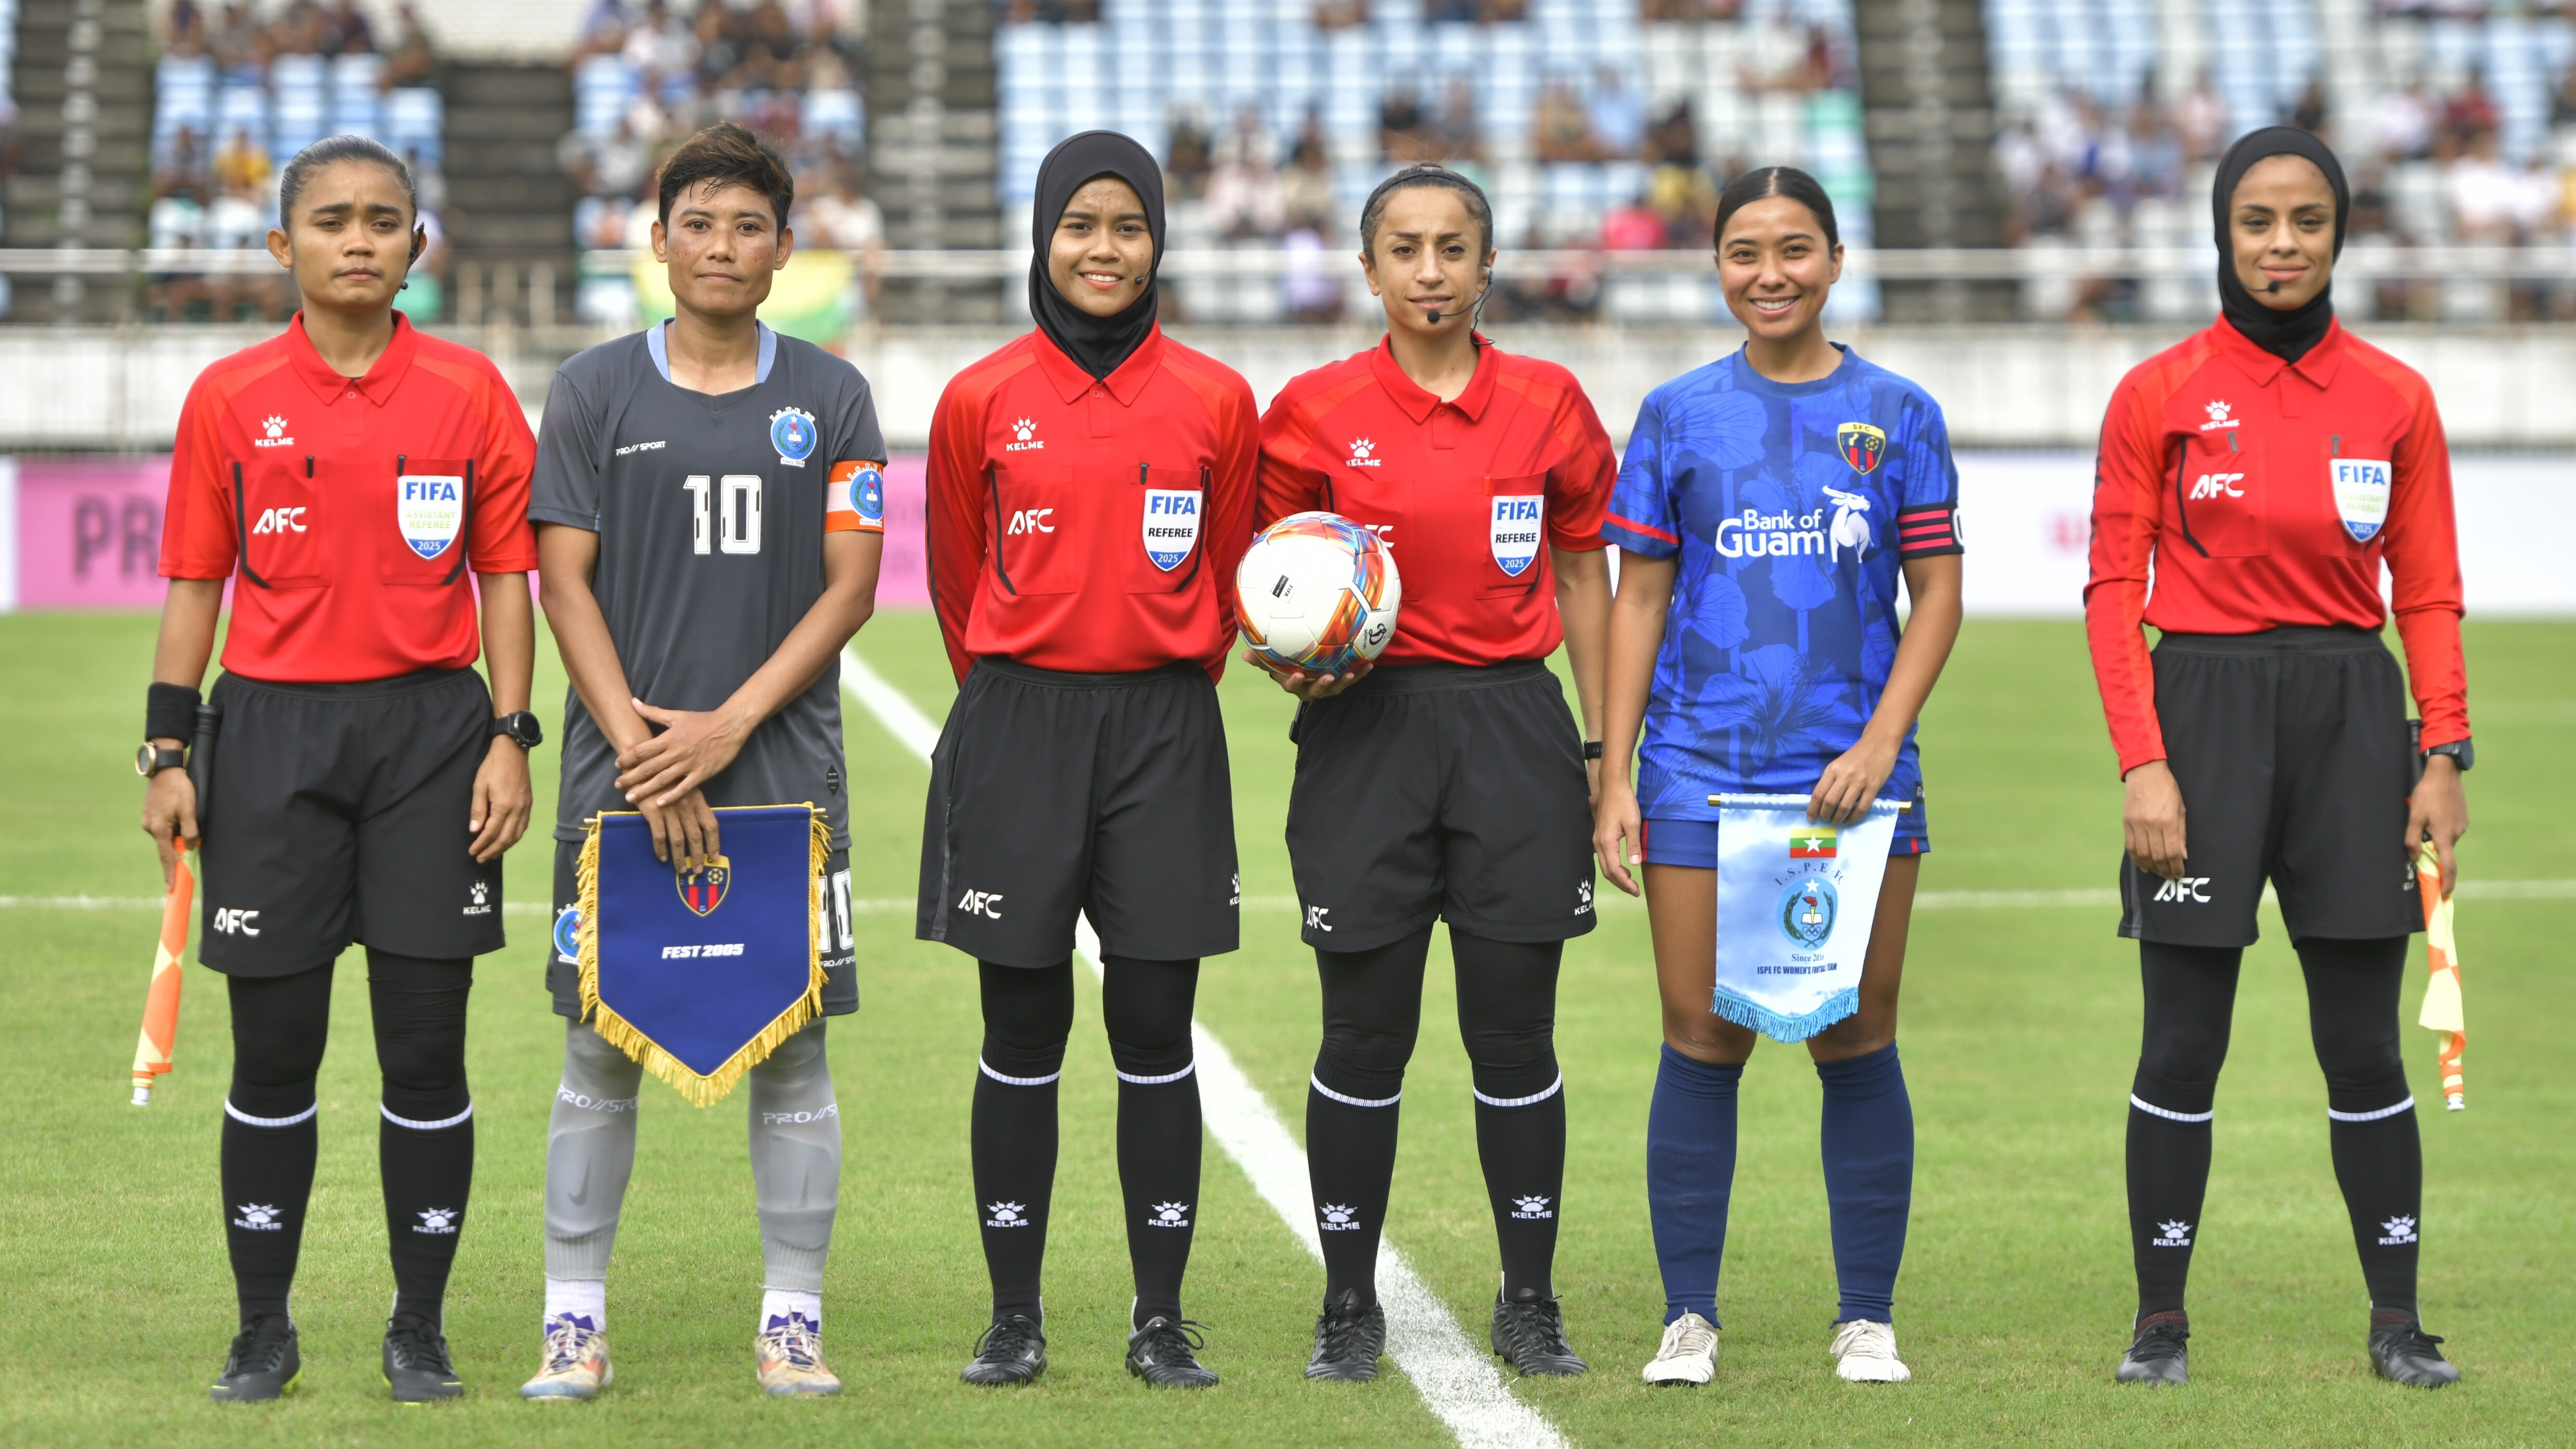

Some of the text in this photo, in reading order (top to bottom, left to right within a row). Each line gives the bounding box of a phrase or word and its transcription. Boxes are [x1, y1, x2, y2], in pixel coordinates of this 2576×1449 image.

[2199, 419, 2240, 431] KELME
[255, 437, 294, 447] KELME
[1006, 441, 1044, 452] KELME
[1345, 458, 1381, 467] KELME
[2339, 465, 2386, 485] FIFA
[405, 482, 457, 501] FIFA
[2189, 473, 2245, 499] AFC
[1151, 495, 1196, 515] FIFA
[1497, 501, 1538, 520] FIFA
[252, 507, 307, 534] AFC
[682, 475, 762, 555] 10
[1744, 509, 1823, 530] Bank of
[409, 520, 451, 529] REFEREE
[1007, 508, 1055, 535] AFC
[1148, 527, 1193, 538] REFEREE
[2353, 522, 2373, 534] 2025
[1495, 532, 1537, 543] REFEREE
[1715, 518, 1825, 558] Guam
[417, 541, 441, 550] 2025
[1157, 554, 1179, 563] 2025
[1504, 559, 1524, 568] 2025
[1284, 584, 1293, 597] FIFA
[2154, 877, 2211, 903] AFC
[463, 904, 491, 915] KELME
[958, 889, 1003, 919] AFC
[213, 907, 260, 936] AFC
[1306, 904, 1332, 932] AFC
[661, 943, 744, 960] FEST 2005
[1757, 966, 1772, 974] ISPE
[1773, 966, 1782, 974] FC
[1783, 966, 1811, 974] WOMEN'S
[1827, 963, 1838, 971] TEAM
[1511, 1210, 1552, 1219] KELME
[234, 1217, 283, 1230] KELME
[987, 1219, 1029, 1228] KELME
[1148, 1219, 1189, 1227] KELME
[1320, 1221, 1361, 1231] KELME
[412, 1225, 457, 1234] KELME
[2152, 1237, 2191, 1247] KELME
[2378, 1232, 2418, 1246] KELME
